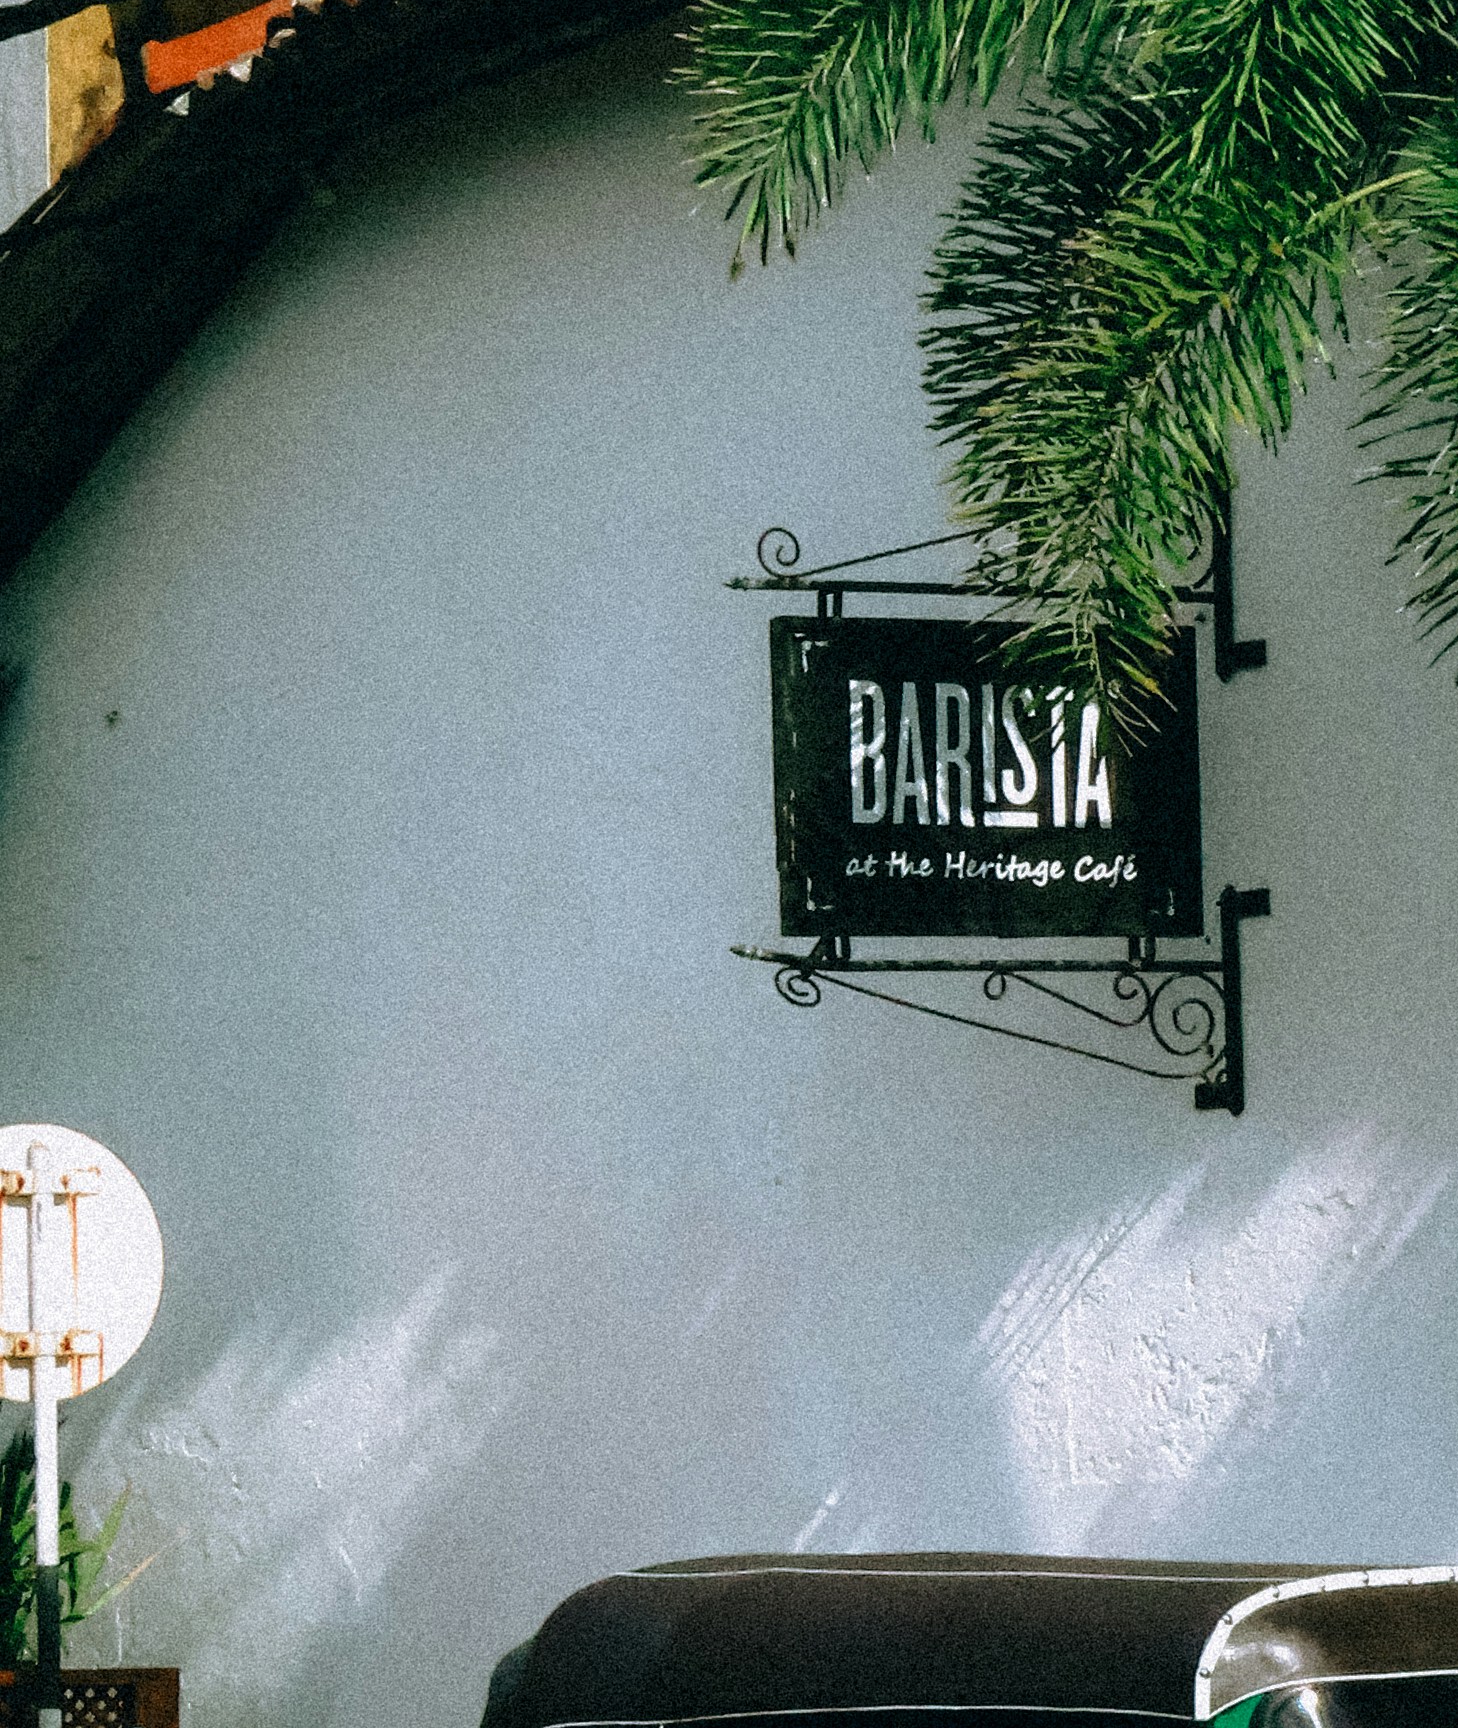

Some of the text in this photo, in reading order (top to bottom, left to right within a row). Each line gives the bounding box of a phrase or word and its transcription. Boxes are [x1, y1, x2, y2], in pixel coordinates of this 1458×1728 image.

[849, 679, 1113, 829] BARISTA
[846, 850, 1138, 889] at the Heritage Café
